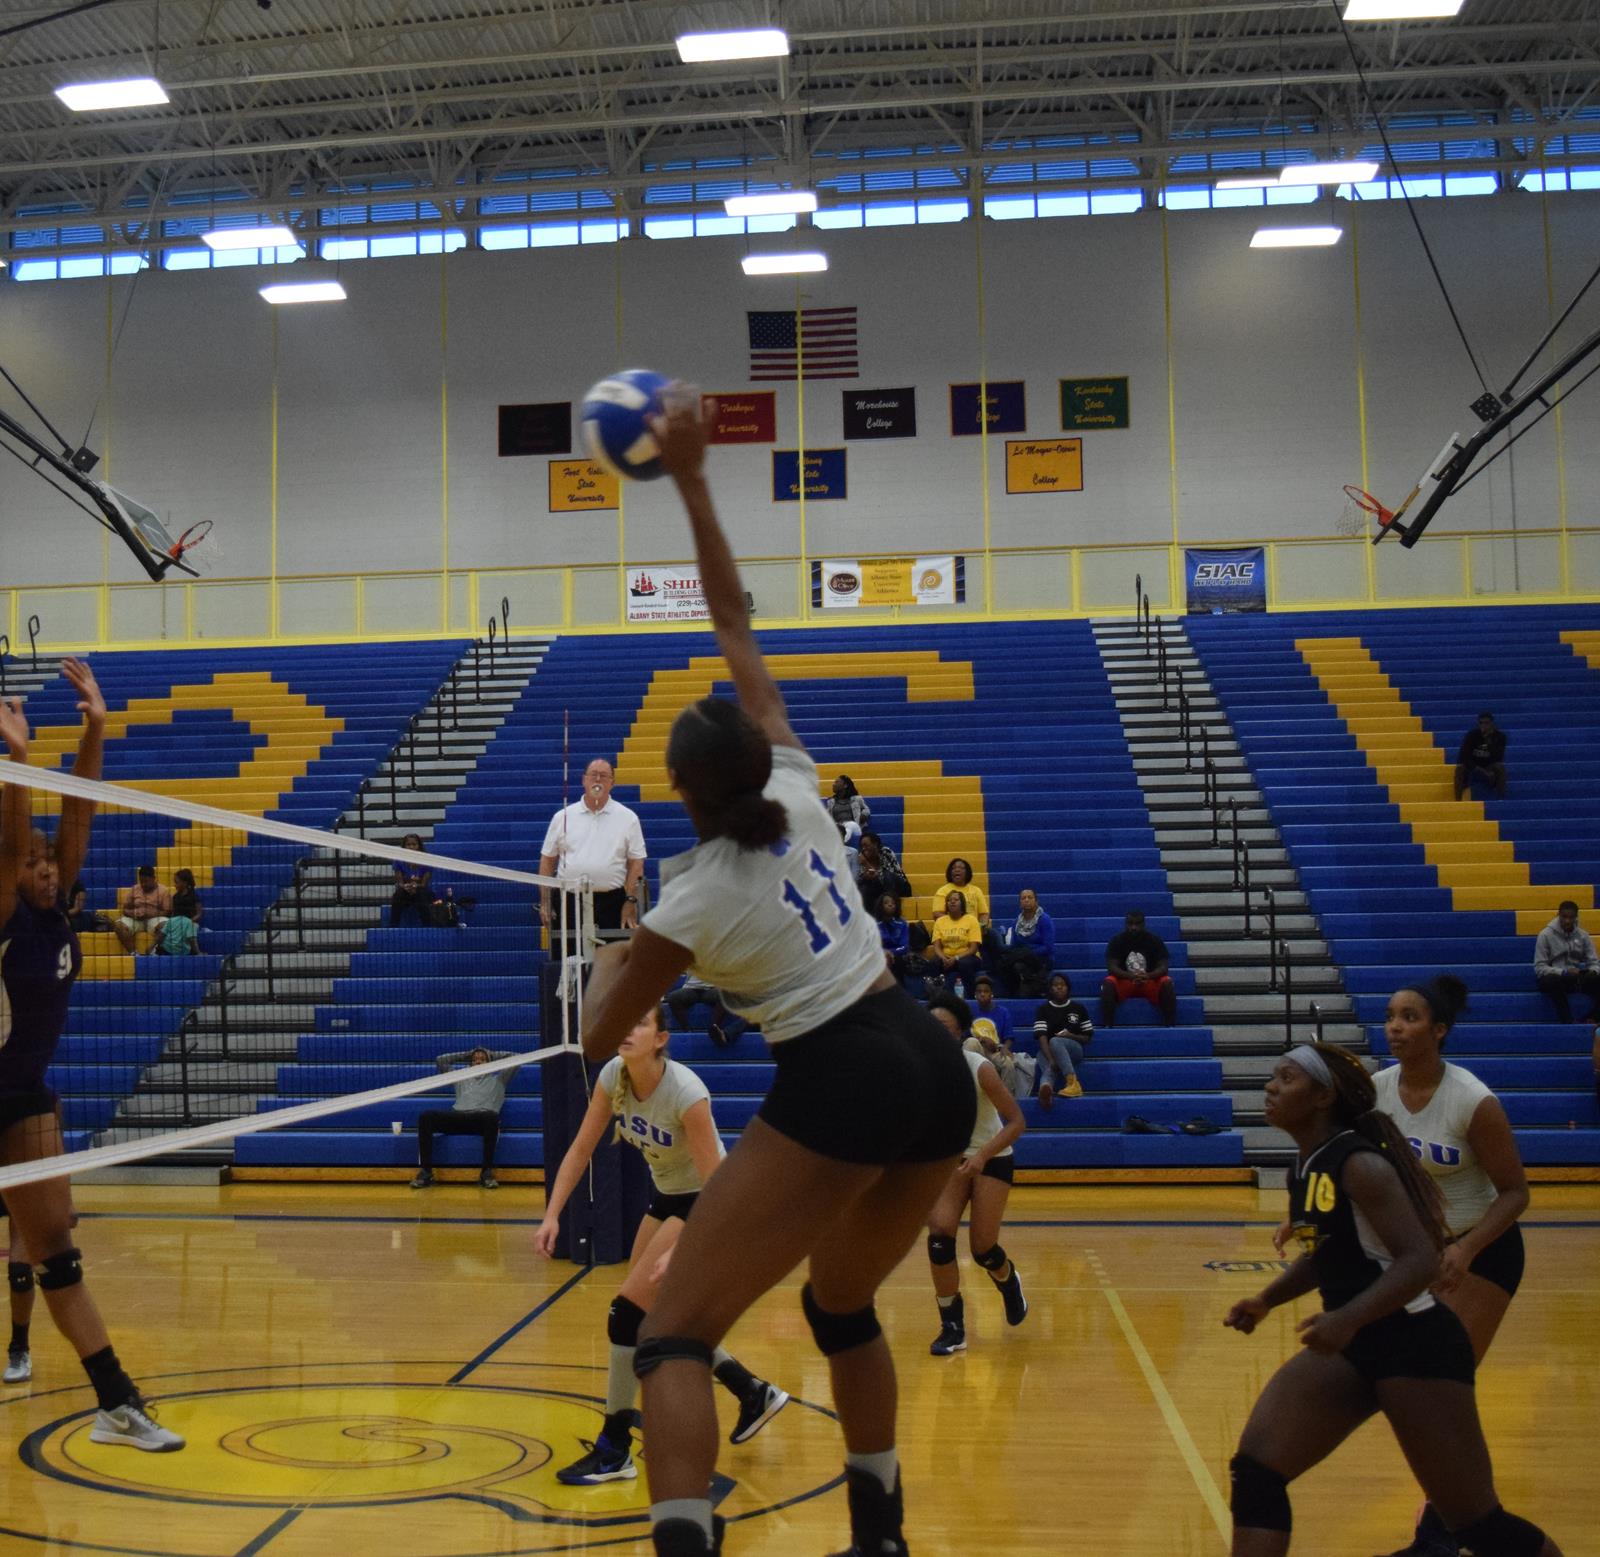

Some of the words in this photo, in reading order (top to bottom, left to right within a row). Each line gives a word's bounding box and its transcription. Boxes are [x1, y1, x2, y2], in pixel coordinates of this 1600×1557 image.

[855, 400, 899, 411] Morehouse
[1084, 398, 1104, 411] State
[865, 416, 893, 430] College
[562, 466, 580, 478] Fort
[576, 478, 595, 490] State
[1032, 472, 1059, 486] College
[567, 493, 605, 504] University
[1195, 563, 1255, 580] SIAC
[663, 579, 705, 590] SHIP
[676, 599, 706, 609] (229)-420
[690, 609, 712, 618] DEPART
[783, 848, 852, 954] 11
[56, 943, 73, 980] 9
[1406, 1136, 1460, 1166] SU
[1303, 1171, 1337, 1213] 10
